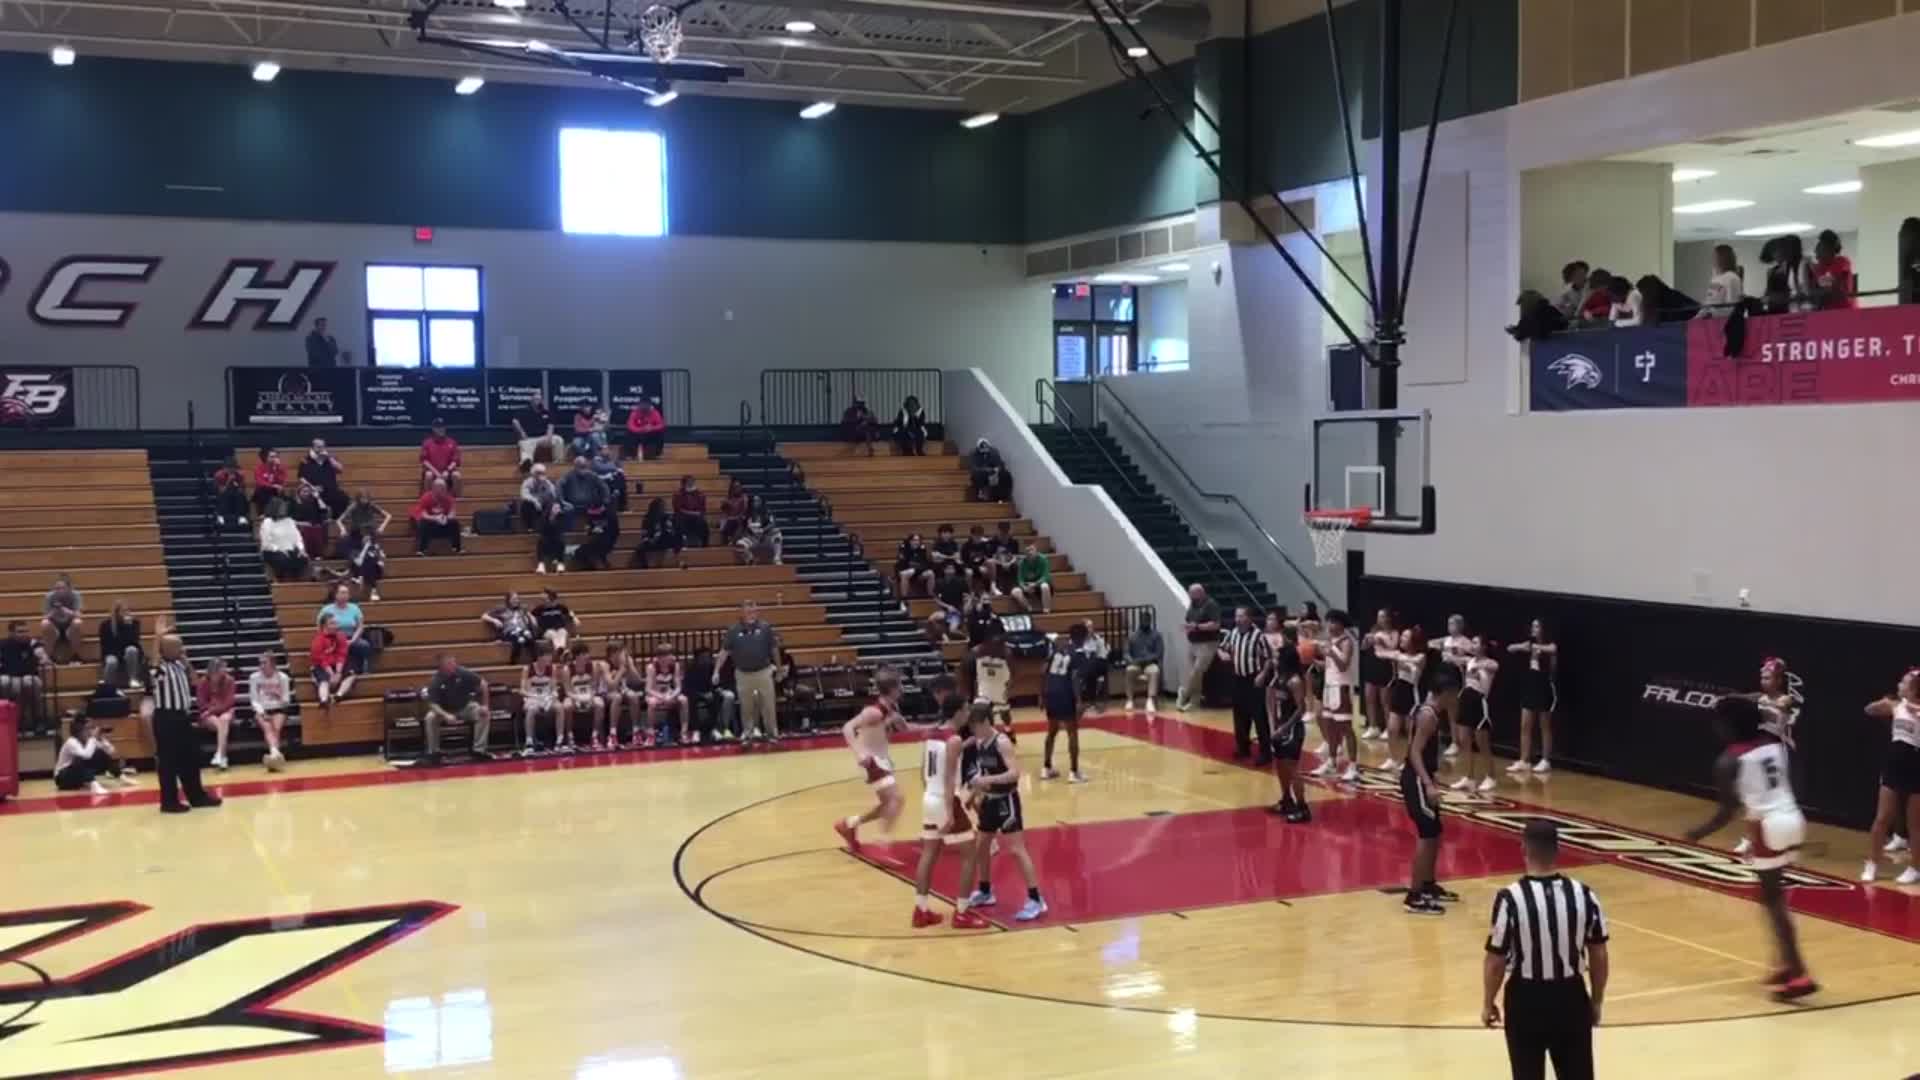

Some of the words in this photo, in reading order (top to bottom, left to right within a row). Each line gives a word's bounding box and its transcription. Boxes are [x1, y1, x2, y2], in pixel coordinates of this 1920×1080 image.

[0, 254, 338, 330] CH
[1761, 337, 1891, 363] STRONGER.
[1903, 334, 1920, 356] T
